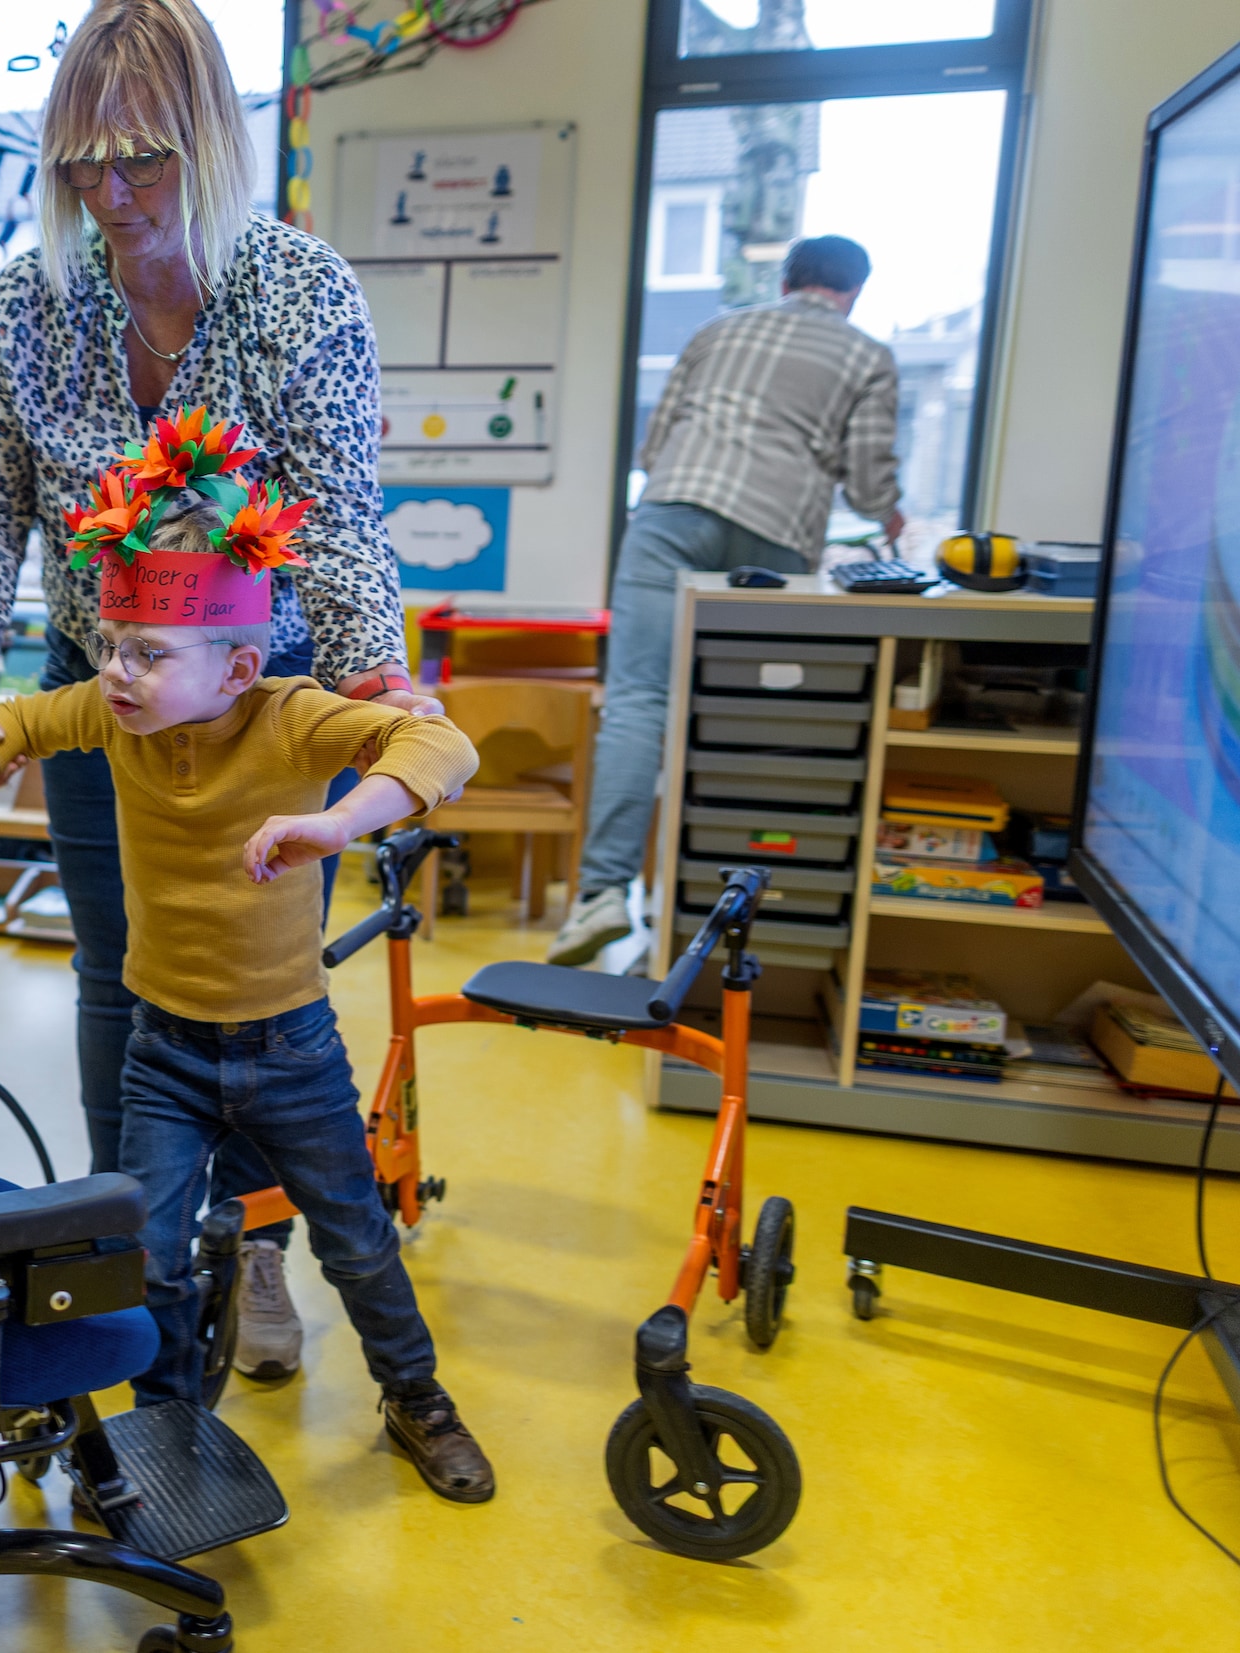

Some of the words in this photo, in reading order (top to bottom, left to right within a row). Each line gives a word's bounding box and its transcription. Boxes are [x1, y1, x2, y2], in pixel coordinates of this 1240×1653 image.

[102, 587, 141, 609] Boet
[152, 594, 171, 611] is
[180, 597, 199, 617] 5
[203, 598, 235, 621] jaar
